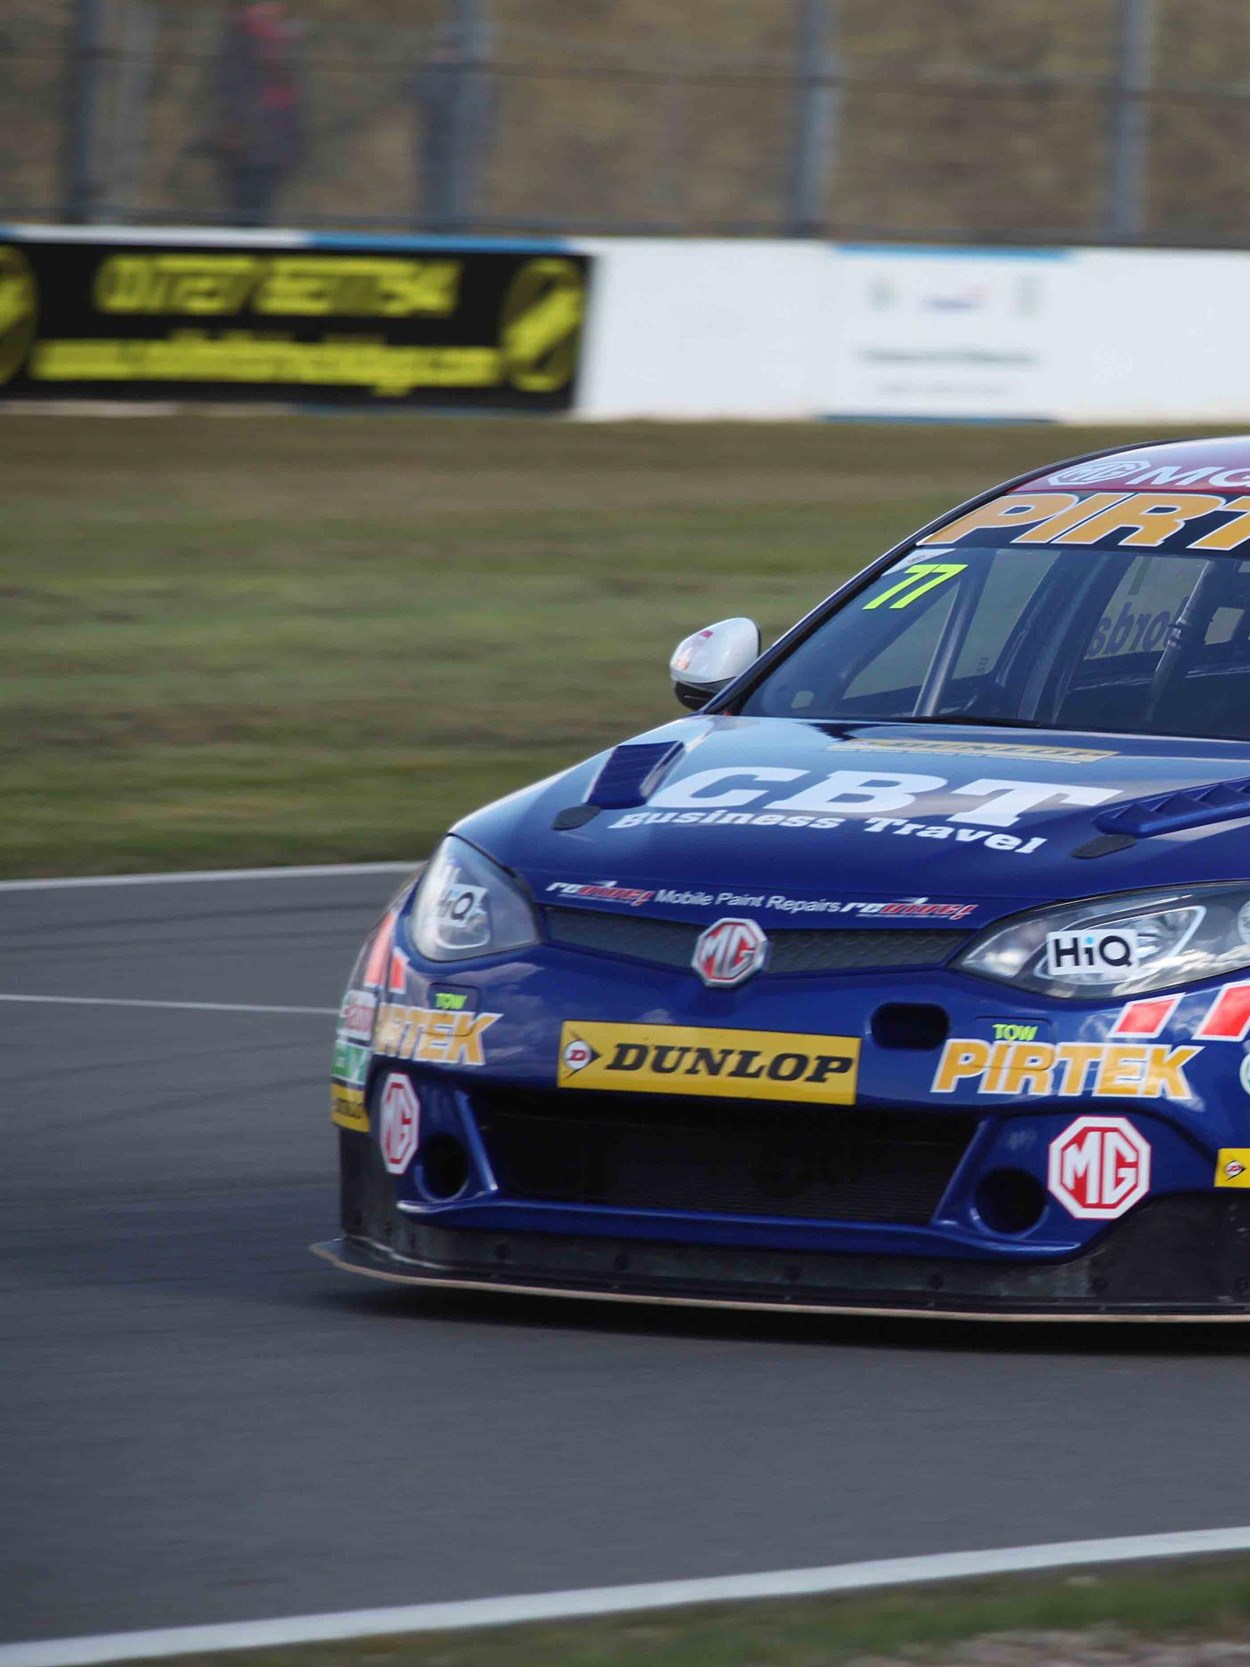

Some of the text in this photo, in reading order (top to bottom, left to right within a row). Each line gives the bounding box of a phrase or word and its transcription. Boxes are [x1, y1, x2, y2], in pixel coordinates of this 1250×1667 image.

[862, 564, 968, 610] 77
[661, 766, 1127, 829] CBT
[607, 810, 1047, 855] Business Travel
[654, 888, 713, 906] Mobile
[715, 892, 766, 908] Paint
[766, 895, 842, 914] Repairs
[701, 922, 758, 980] MG
[1054, 935, 1132, 967] HiQ
[991, 1024, 1038, 1041] TOW
[606, 1042, 853, 1083] DUNLOP
[930, 1038, 1205, 1100] PIRTEK
[1059, 1128, 1140, 1207] MG
